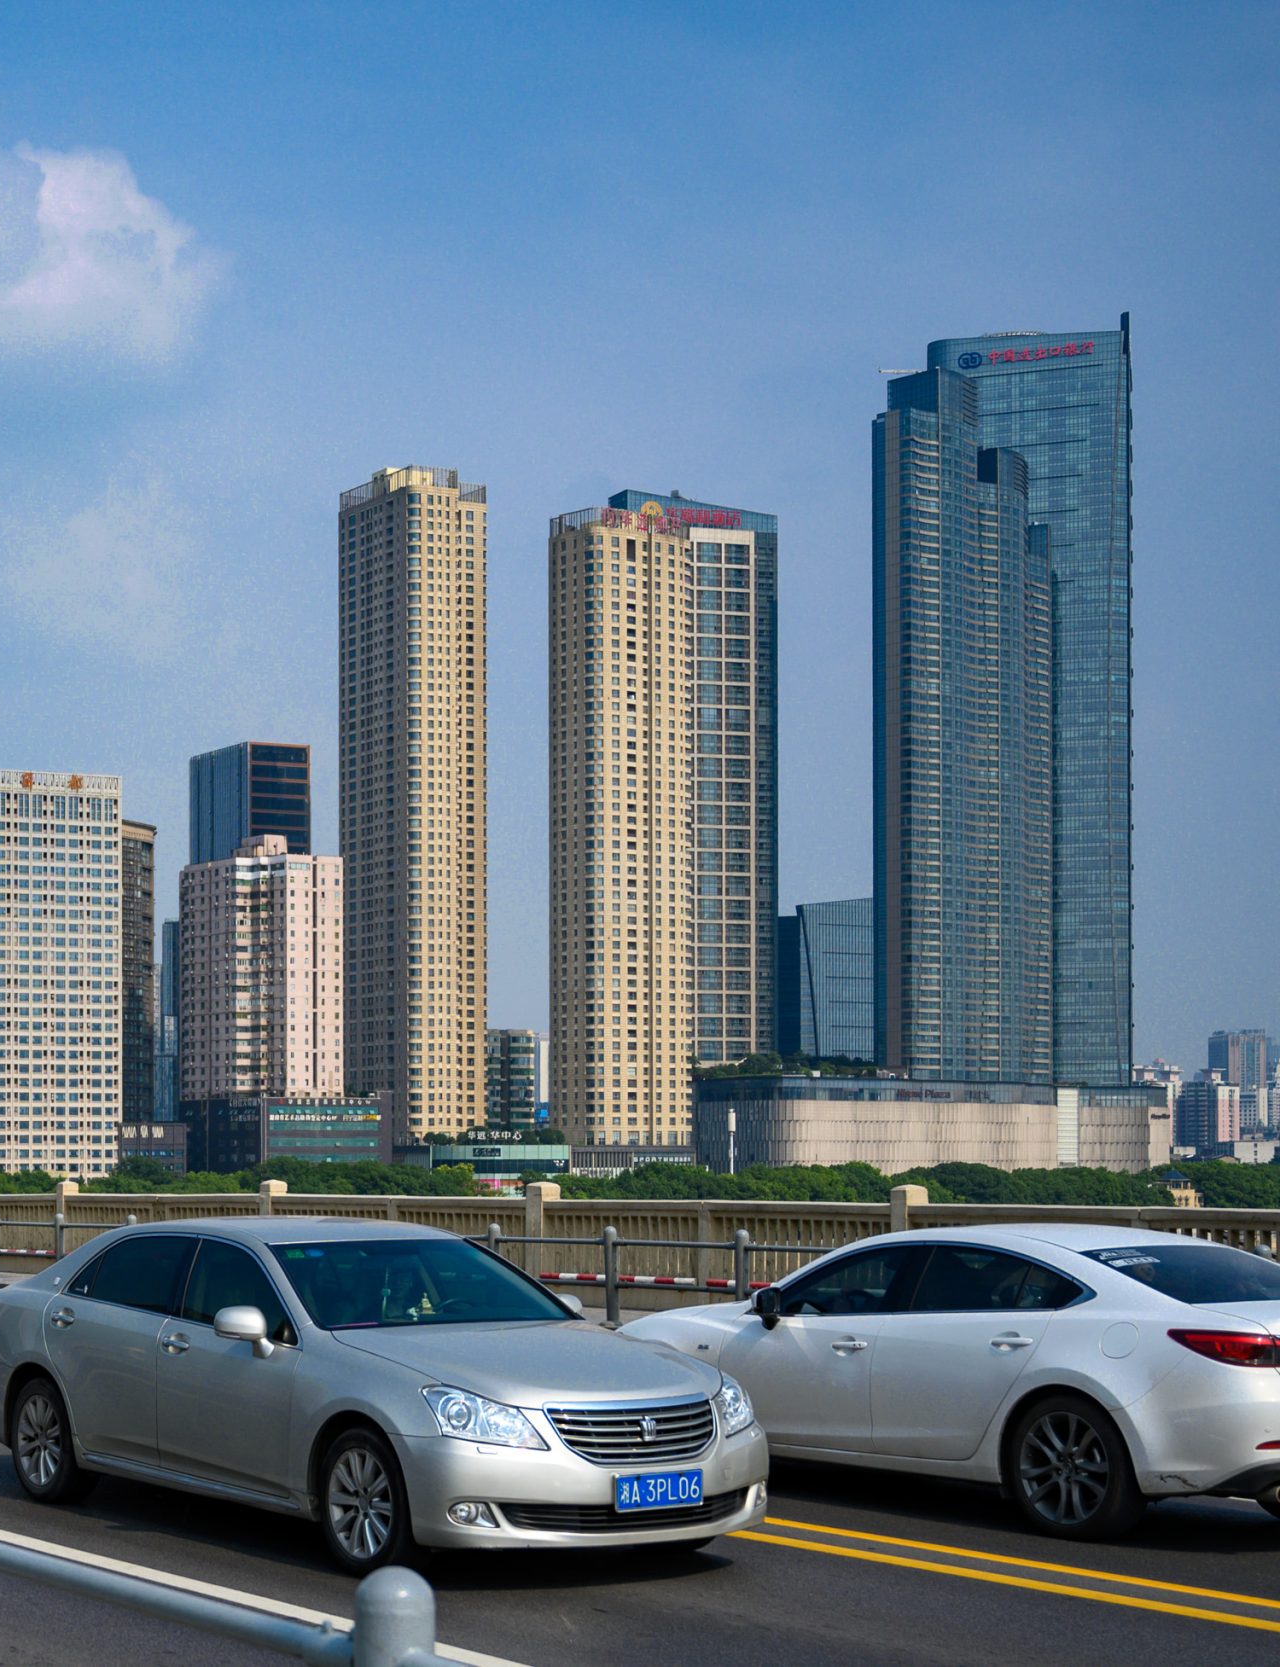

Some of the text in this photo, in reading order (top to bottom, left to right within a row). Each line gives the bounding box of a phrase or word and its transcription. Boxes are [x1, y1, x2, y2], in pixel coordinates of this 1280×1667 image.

[987, 341, 1095, 367] 中国进出口银行
